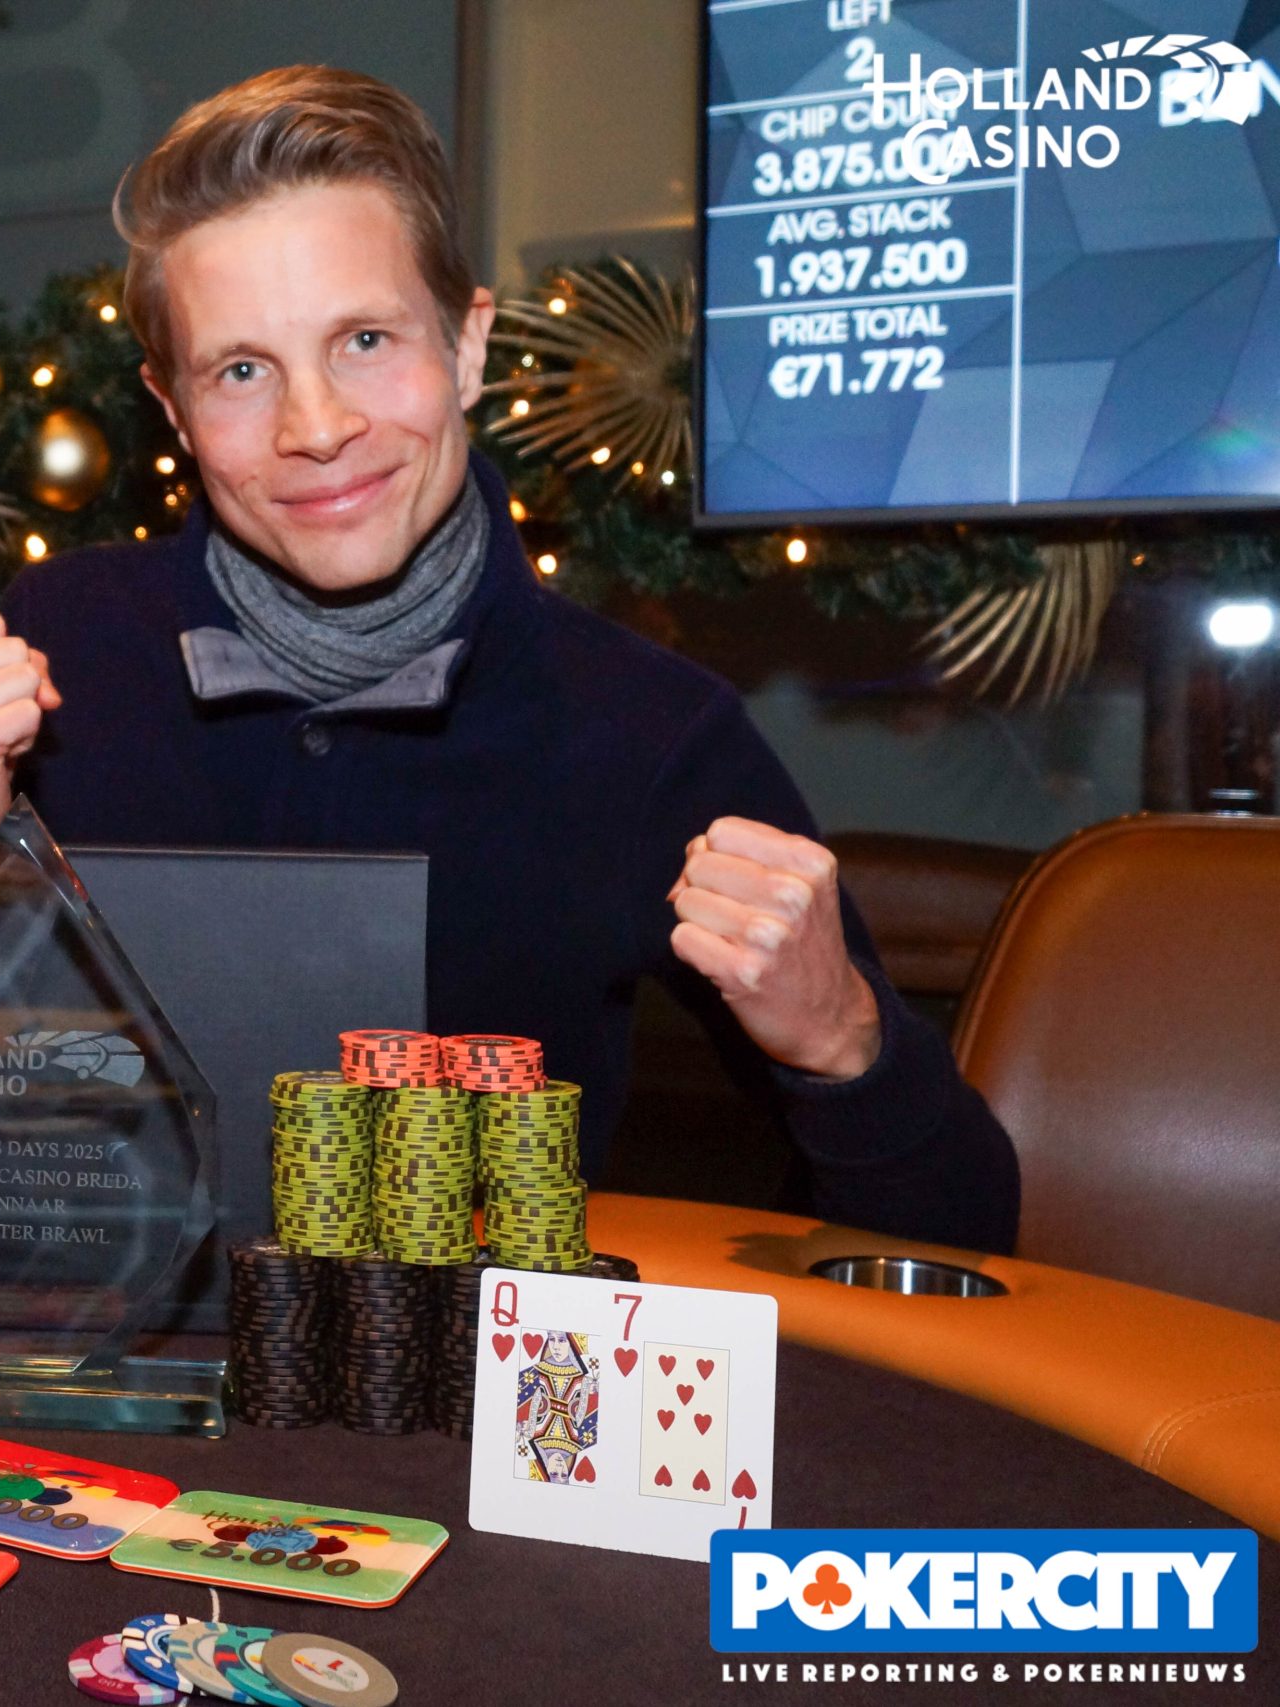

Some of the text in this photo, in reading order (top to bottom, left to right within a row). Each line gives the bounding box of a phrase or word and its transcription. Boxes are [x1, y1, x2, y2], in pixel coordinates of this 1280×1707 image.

[827, 0, 891, 31] LEFT
[844, 36, 876, 82] 2
[760, 104, 838, 143] CHIP
[752, 130, 970, 197] 3.875.000
[767, 197, 952, 246] AVG. STACK
[754, 237, 968, 299] 1.937.500
[768, 304, 948, 348] PRIZE TOTAL
[768, 344, 946, 400] €71.772
[7, 1141, 60, 1159] DAYS
[63, 1143, 104, 1161] 2025
[75, 1171, 143, 1191] BREDA
[40, 1225, 111, 1245] BRAWL
[490, 1281, 520, 1328] Q
[614, 1293, 643, 1341] 7
